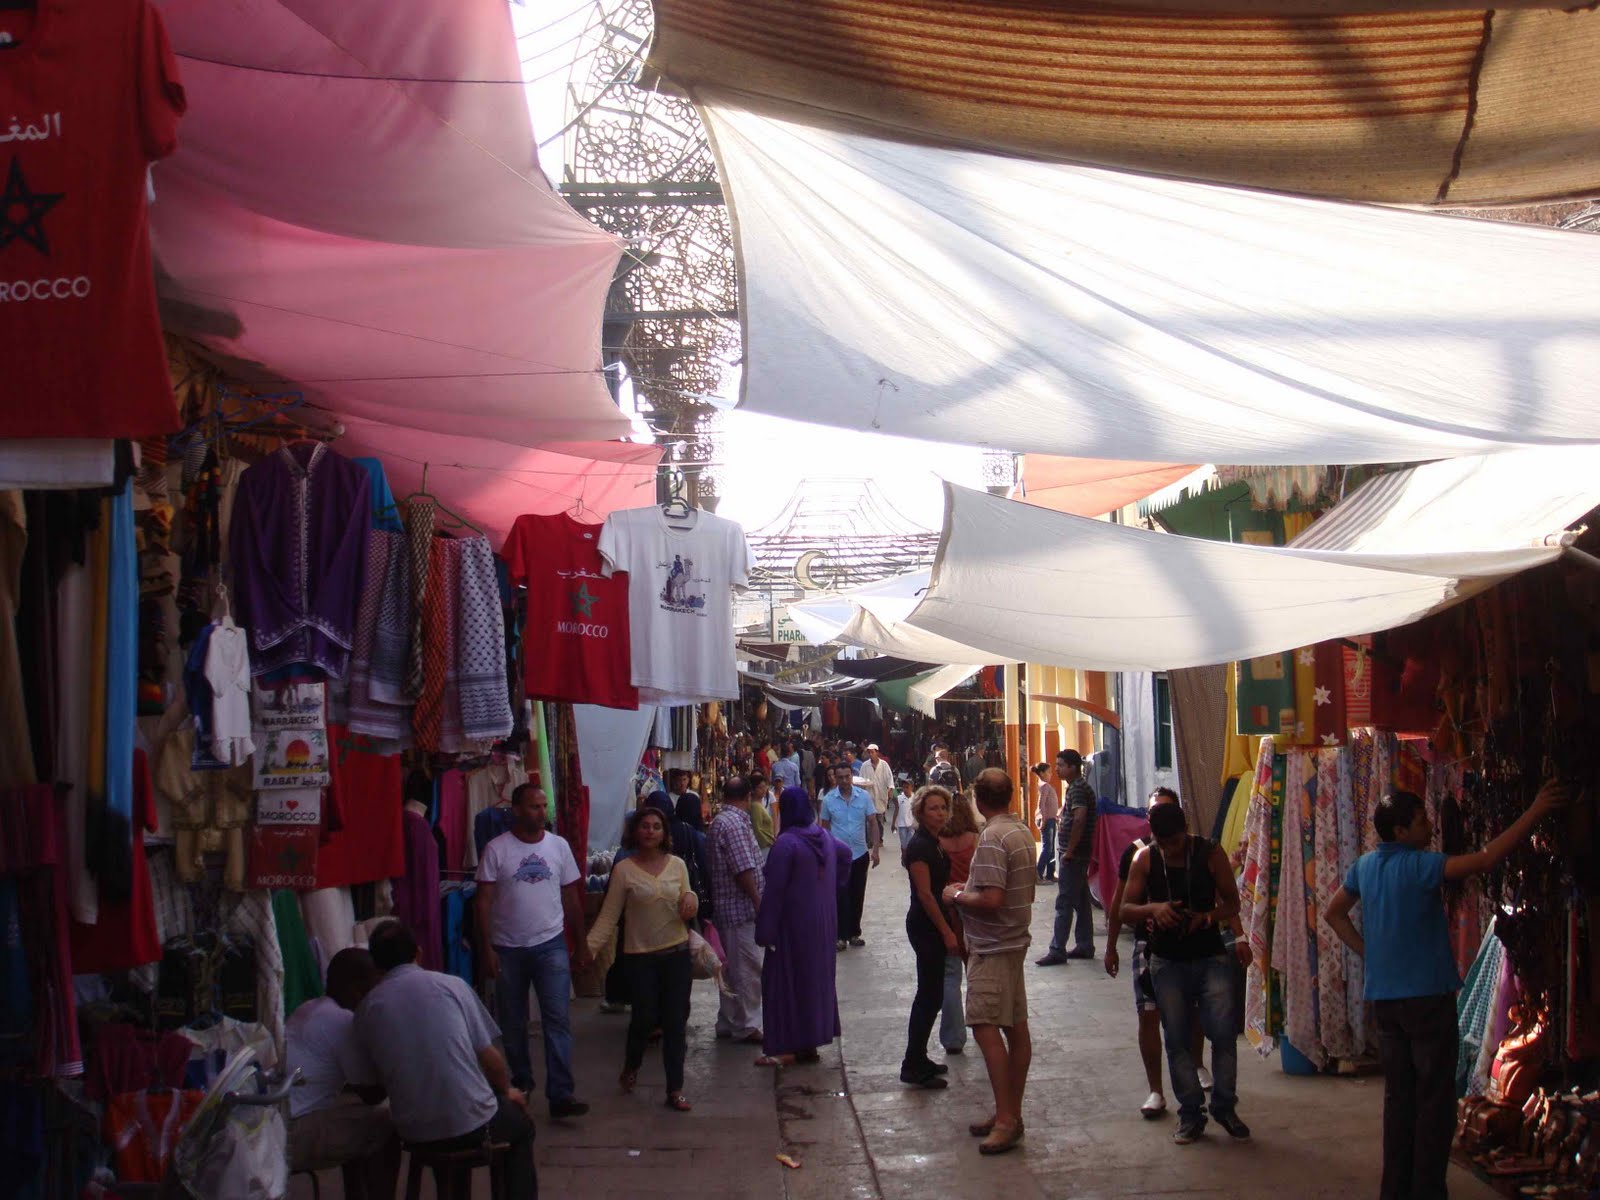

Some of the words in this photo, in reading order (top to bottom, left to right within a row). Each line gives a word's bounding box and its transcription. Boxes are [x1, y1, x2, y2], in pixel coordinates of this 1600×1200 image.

[557, 621, 608, 638] MOROCCO
[261, 715, 319, 726] MARRAKECH
[263, 776, 299, 786] RABAT
[260, 811, 317, 821] MOROCCO
[256, 873, 316, 886] MOROCCO
